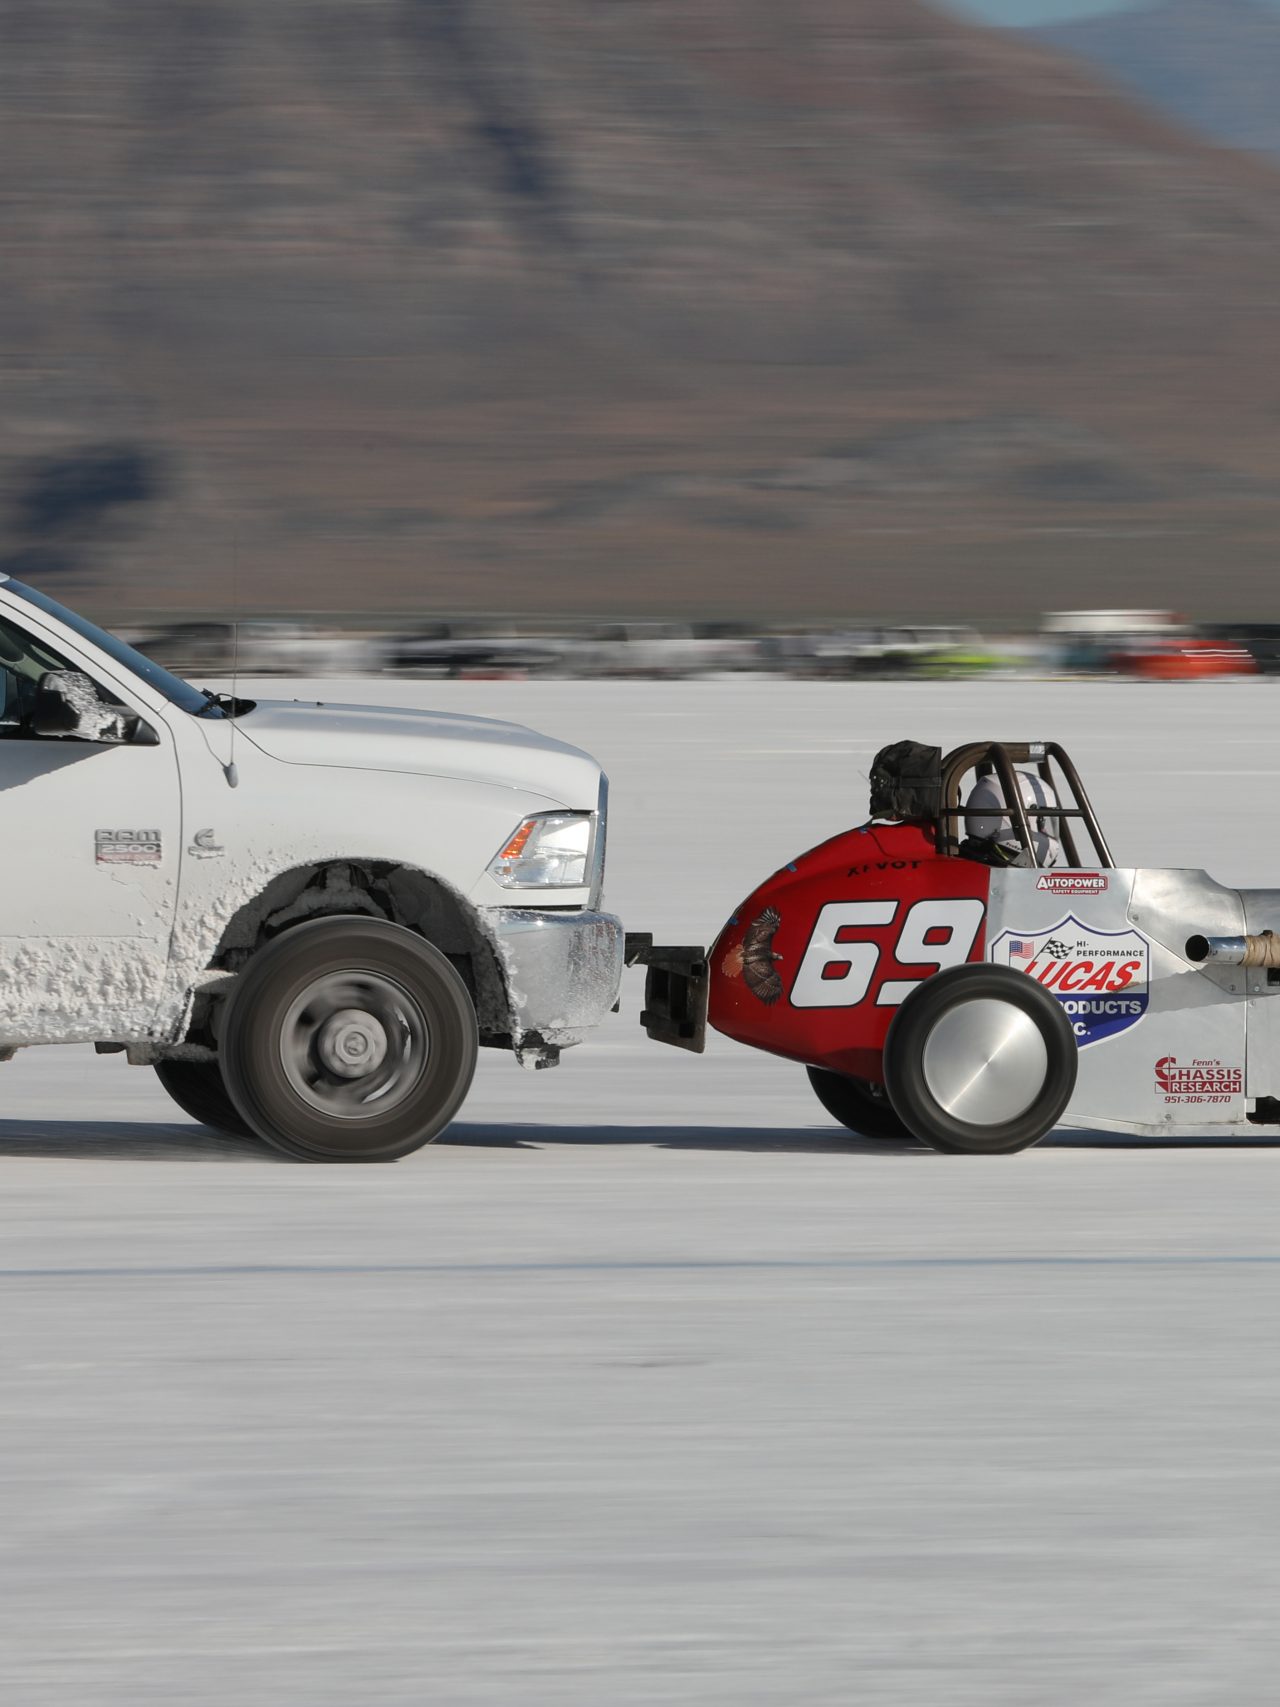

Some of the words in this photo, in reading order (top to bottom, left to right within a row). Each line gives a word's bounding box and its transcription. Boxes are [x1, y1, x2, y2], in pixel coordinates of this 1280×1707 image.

[102, 843, 157, 853] 2500
[1037, 876, 1105, 889] AUTOPOWER
[789, 899, 986, 1008] 69
[1060, 1000, 1142, 1015] ODUCTS
[1154, 1056, 1242, 1081] CHASSIS
[1192, 1059, 1221, 1067] Fenn's
[1171, 1081, 1241, 1092] RESEARCH
[1164, 1095, 1232, 1104] 951-306-7870
